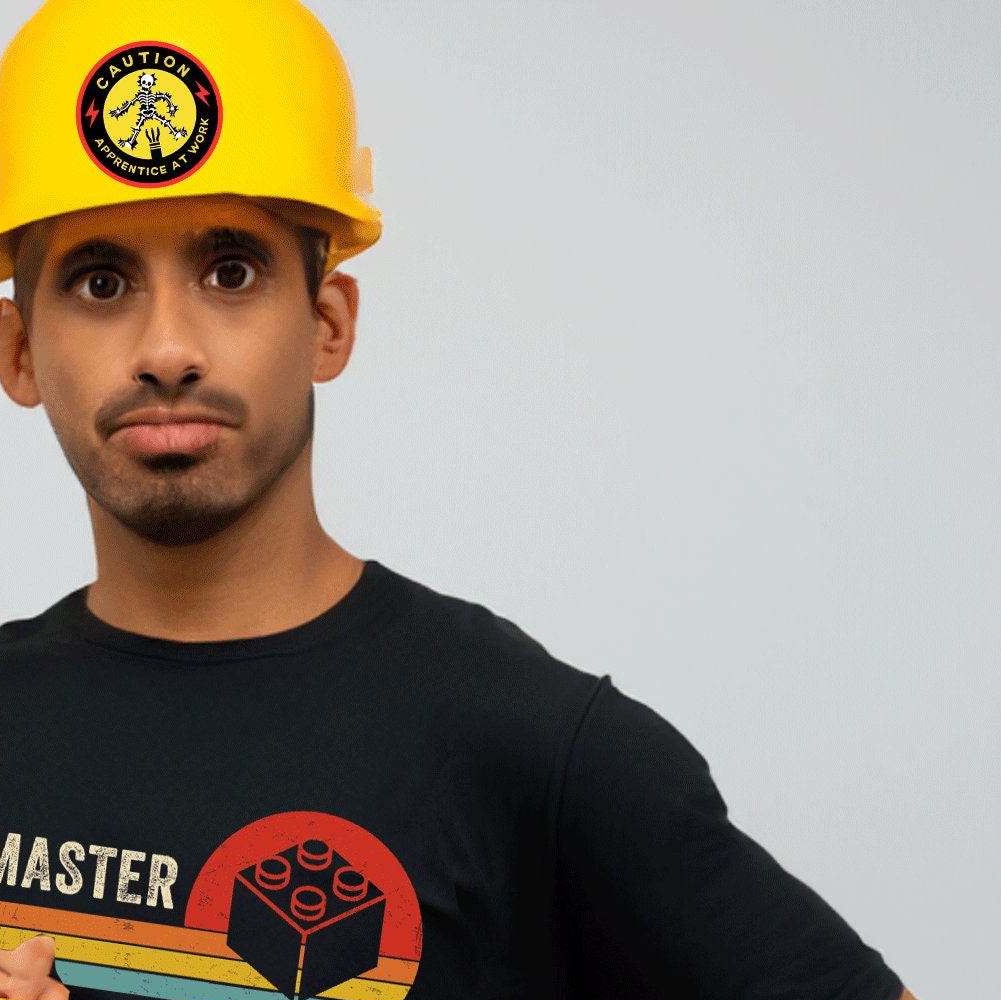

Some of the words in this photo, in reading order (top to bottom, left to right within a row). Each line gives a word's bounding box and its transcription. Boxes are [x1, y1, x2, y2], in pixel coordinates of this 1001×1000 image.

[97, 52, 190, 89] CAUTION
[94, 138, 167, 176] APPRENTICE
[172, 154, 188, 171] AT
[187, 117, 210, 155] WORK
